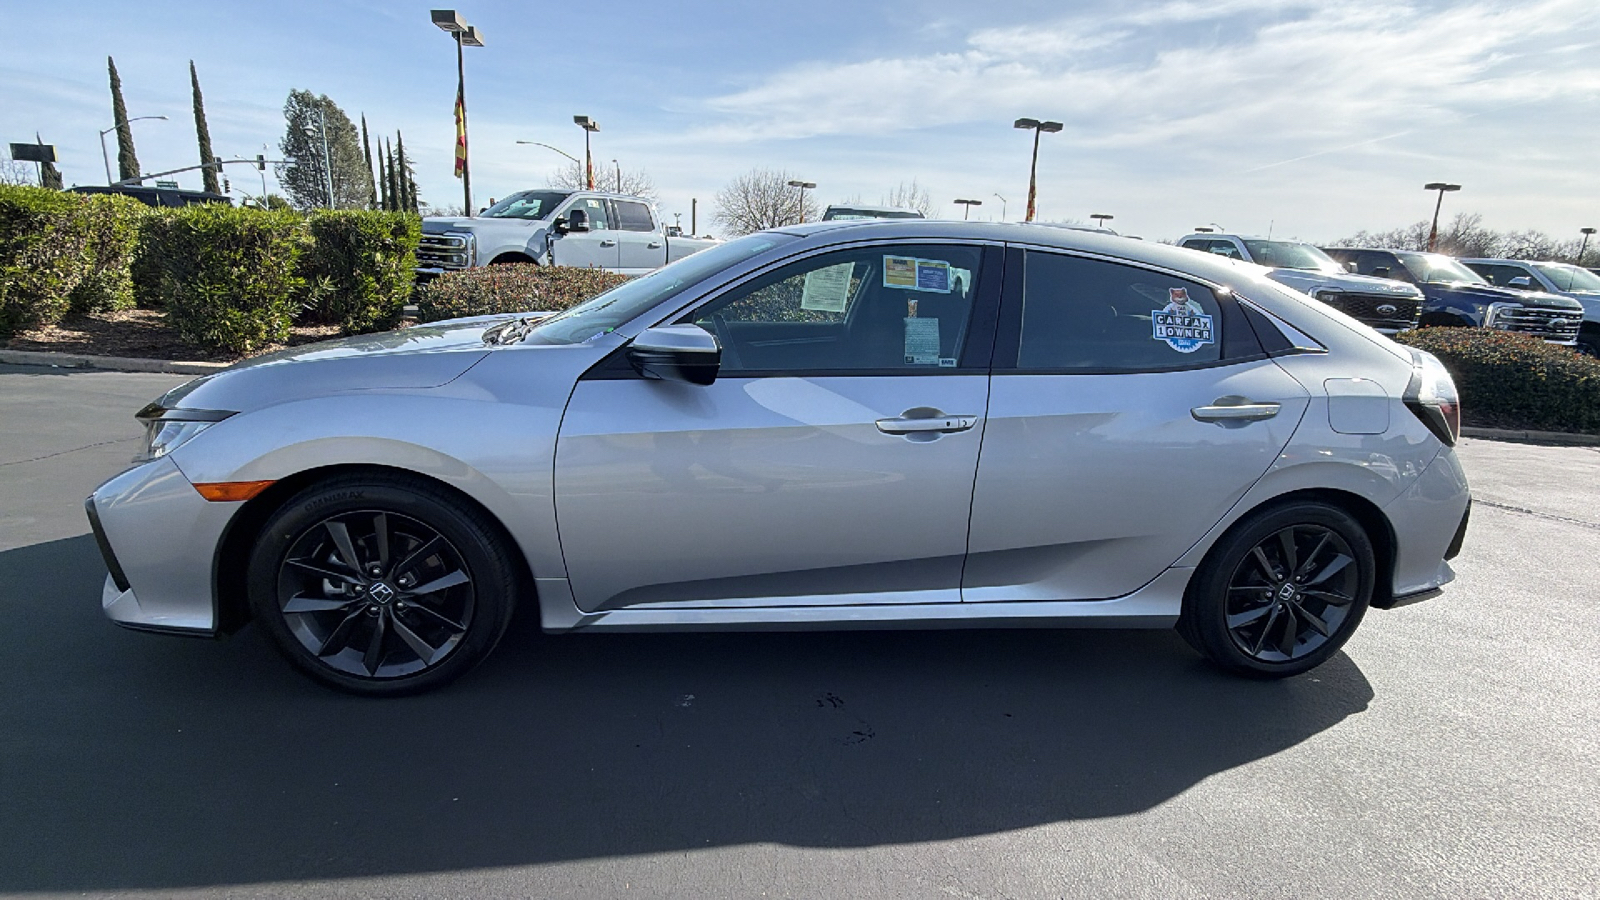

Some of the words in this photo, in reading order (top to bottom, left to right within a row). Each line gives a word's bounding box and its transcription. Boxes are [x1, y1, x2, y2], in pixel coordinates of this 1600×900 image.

[1157, 316, 1209, 329] CARFAX
[1158, 327, 1164, 335] 1
[1167, 327, 1209, 339] OWNER
